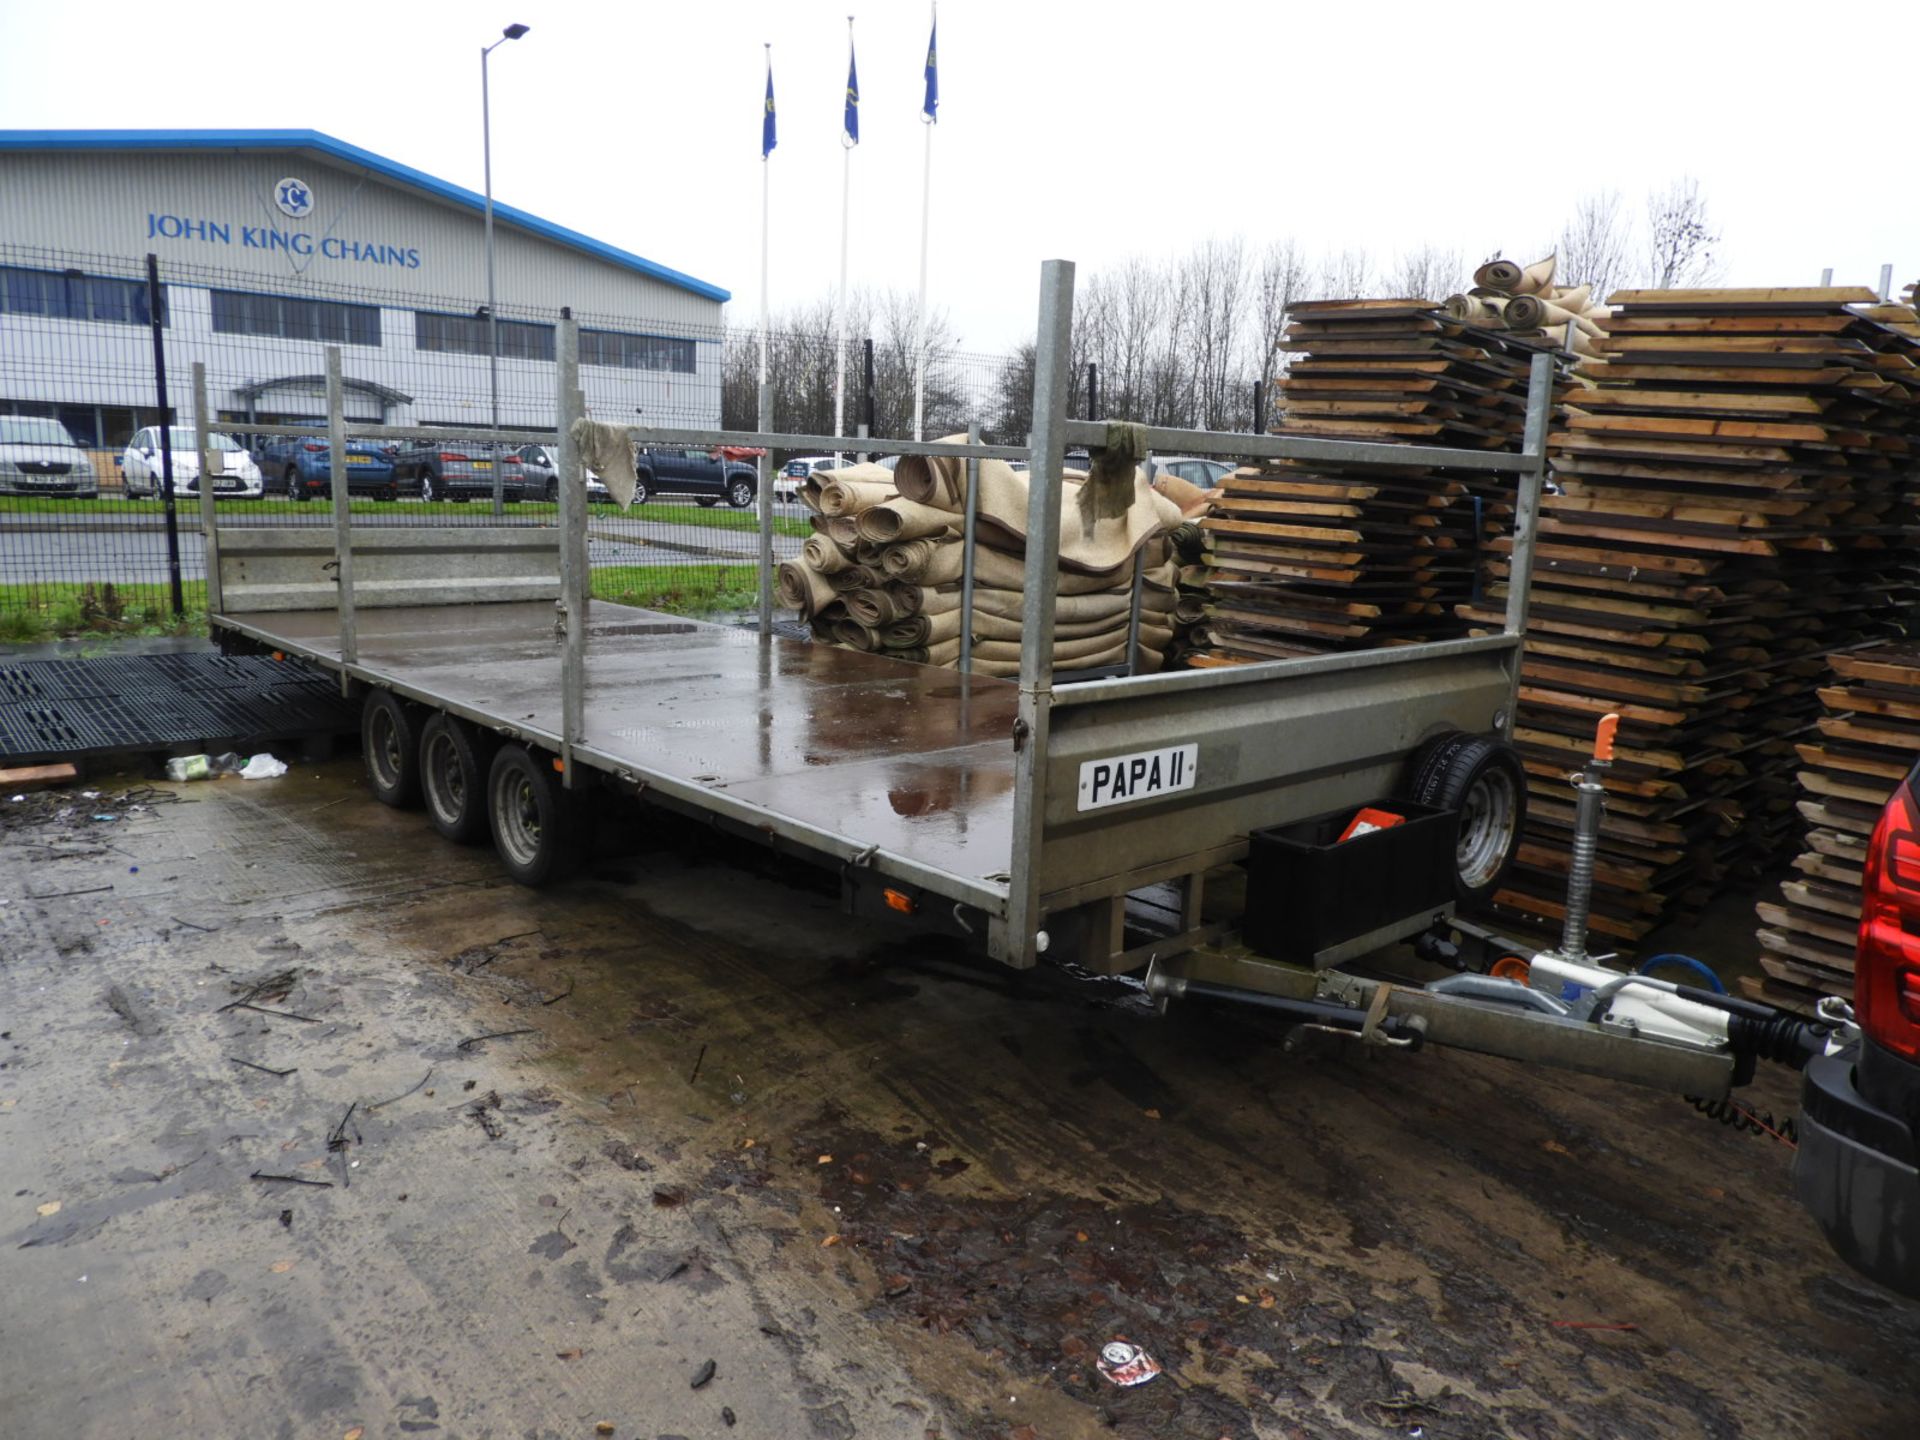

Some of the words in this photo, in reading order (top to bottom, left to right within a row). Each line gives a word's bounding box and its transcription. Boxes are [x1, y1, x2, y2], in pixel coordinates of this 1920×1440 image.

[147, 213, 231, 245] JOHN
[242, 226, 313, 256] KING
[321, 237, 421, 270] CHAINS
[1092, 755, 1162, 803] PAPA
